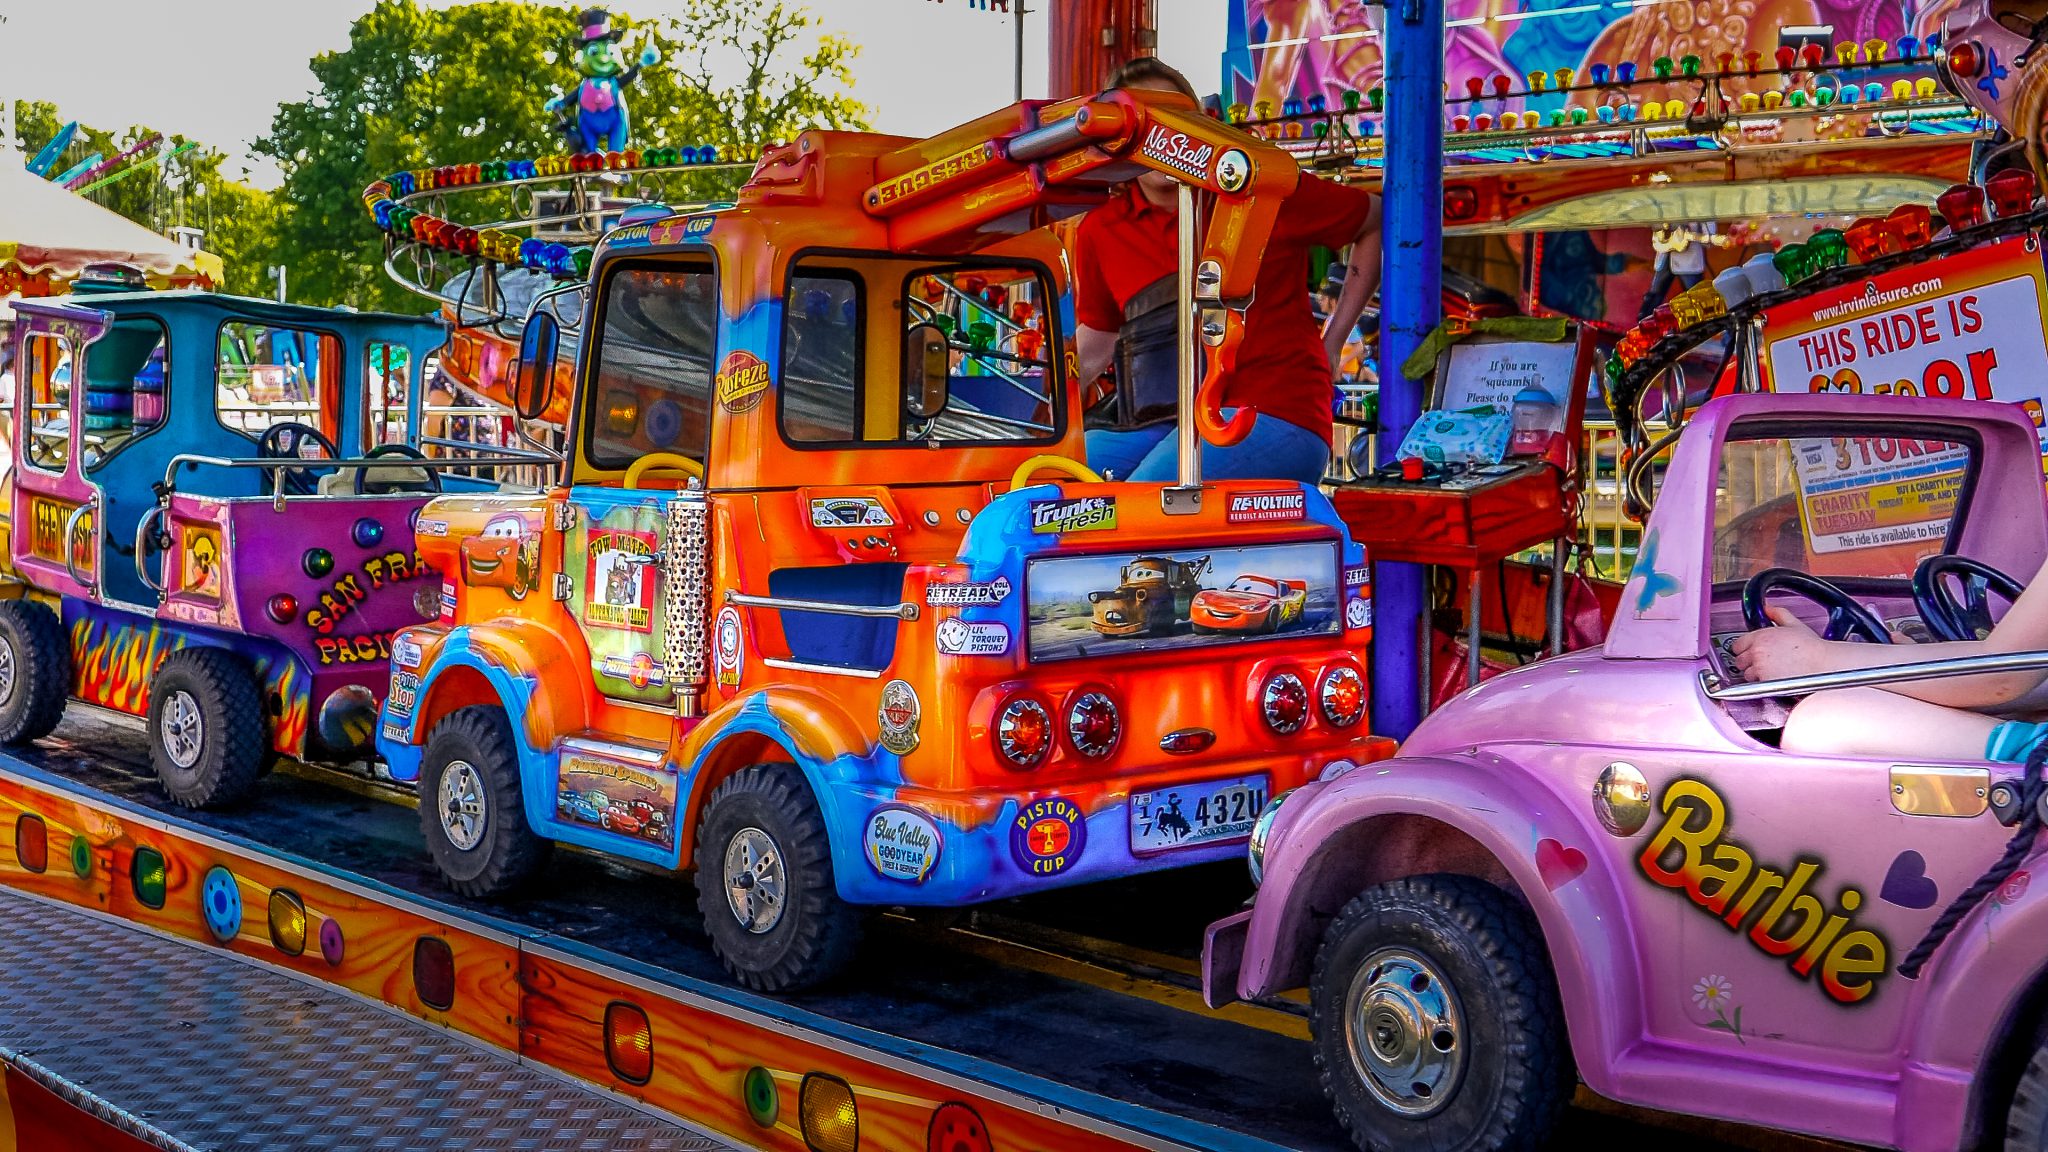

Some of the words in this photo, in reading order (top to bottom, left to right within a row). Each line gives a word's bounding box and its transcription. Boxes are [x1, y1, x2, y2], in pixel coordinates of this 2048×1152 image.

[1145, 125, 1168, 150] No
[1166, 133, 1212, 169] Stall
[881, 147, 984, 203] RESCUE
[609, 225, 650, 241] PISTON
[687, 219, 712, 233] CUP
[1813, 276, 1943, 323] www.irvinleisure.com
[1798, 328, 1857, 372] THIS
[1861, 305, 1941, 358] RIDE
[1947, 295, 1983, 337] IS
[1489, 361, 1500, 372] If
[1499, 363, 1518, 374] you
[1520, 362, 1538, 371] are
[1922, 347, 1998, 401] or
[1466, 393, 1494, 403] Please
[1496, 392, 1510, 403] do
[1805, 452, 1823, 465] VISA
[1832, 437, 1852, 471] 3
[1230, 512, 1257, 521] REBUILT
[1258, 510, 1303, 519] ALTERNATORS
[1812, 491, 1870, 514] CHARITY
[1056, 504, 1115, 532] fresh
[1815, 509, 1876, 530] TUESDAY
[60, 507, 93, 564] WST
[590, 534, 612, 560] TOW
[1838, 533, 1856, 548] This
[1855, 530, 1871, 546] ride
[1872, 530, 1880, 543] is
[1881, 527, 1917, 543] available
[1917, 526, 1927, 537] to
[1928, 523, 1946, 537] hire
[307, 574, 364, 634] SAN
[926, 588, 988, 598] RETREAD
[972, 626, 987, 634] LIL'
[314, 633, 394, 665] PACI
[971, 644, 1004, 652] PISTONS
[1017, 801, 1079, 830] PISTON
[1194, 789, 1262, 828] 432U
[875, 816, 897, 842] Blue
[898, 821, 931, 856] Valley
[879, 845, 923, 865] GOODYEAR
[1034, 856, 1065, 873] CUP
[1639, 779, 1887, 1003] Barbie
